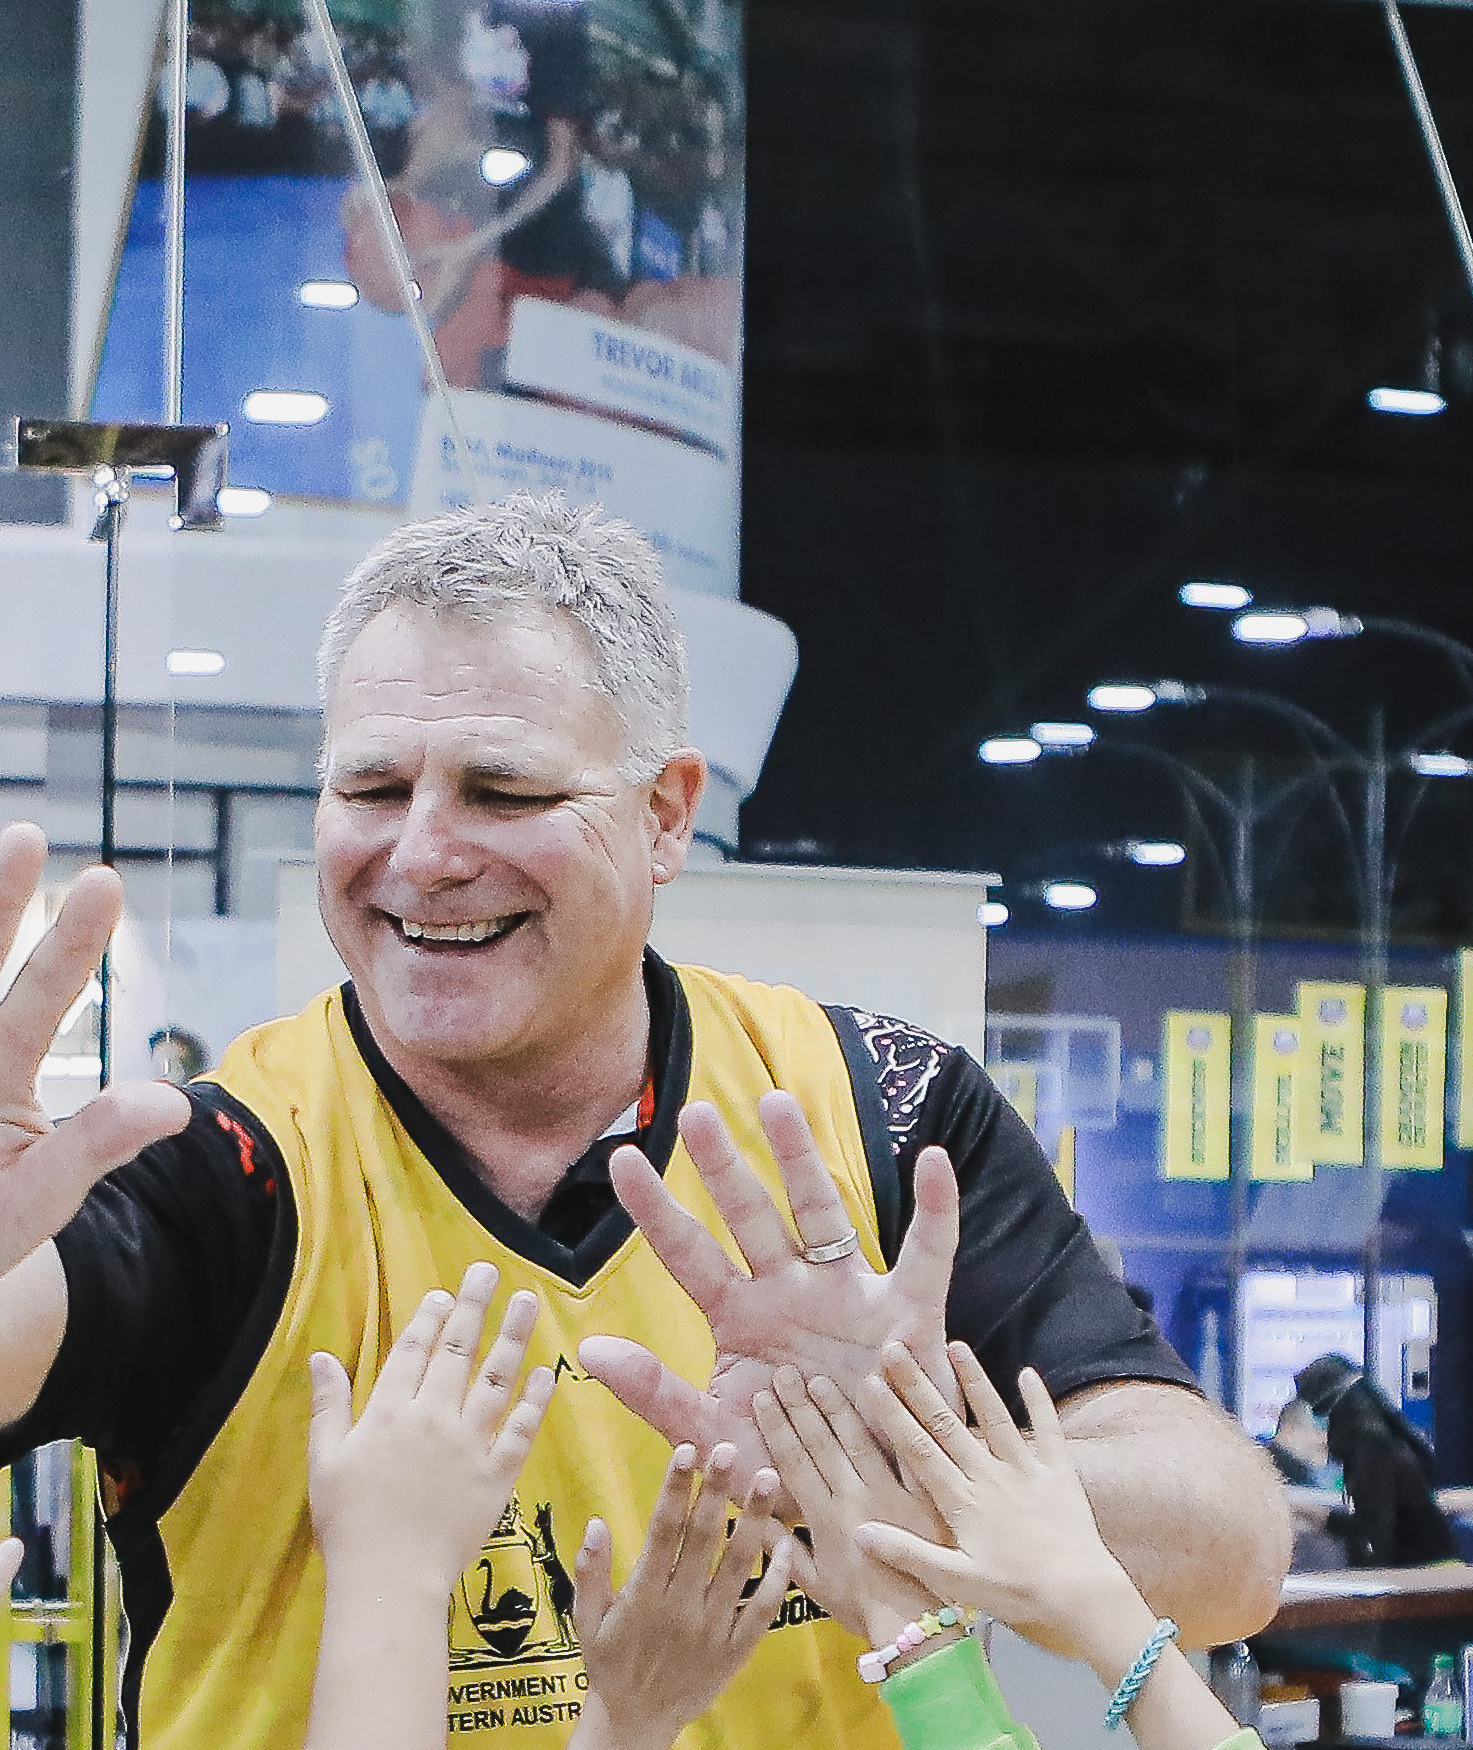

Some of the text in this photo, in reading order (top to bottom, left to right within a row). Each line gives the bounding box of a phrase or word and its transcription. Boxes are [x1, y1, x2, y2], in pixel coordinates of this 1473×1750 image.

[591, 329, 676, 382] TREVOR
[1320, 1041, 1345, 1135] MOVE
[448, 1674, 567, 1704] VERNMENT
[510, 1701, 583, 1727] AUSTR
